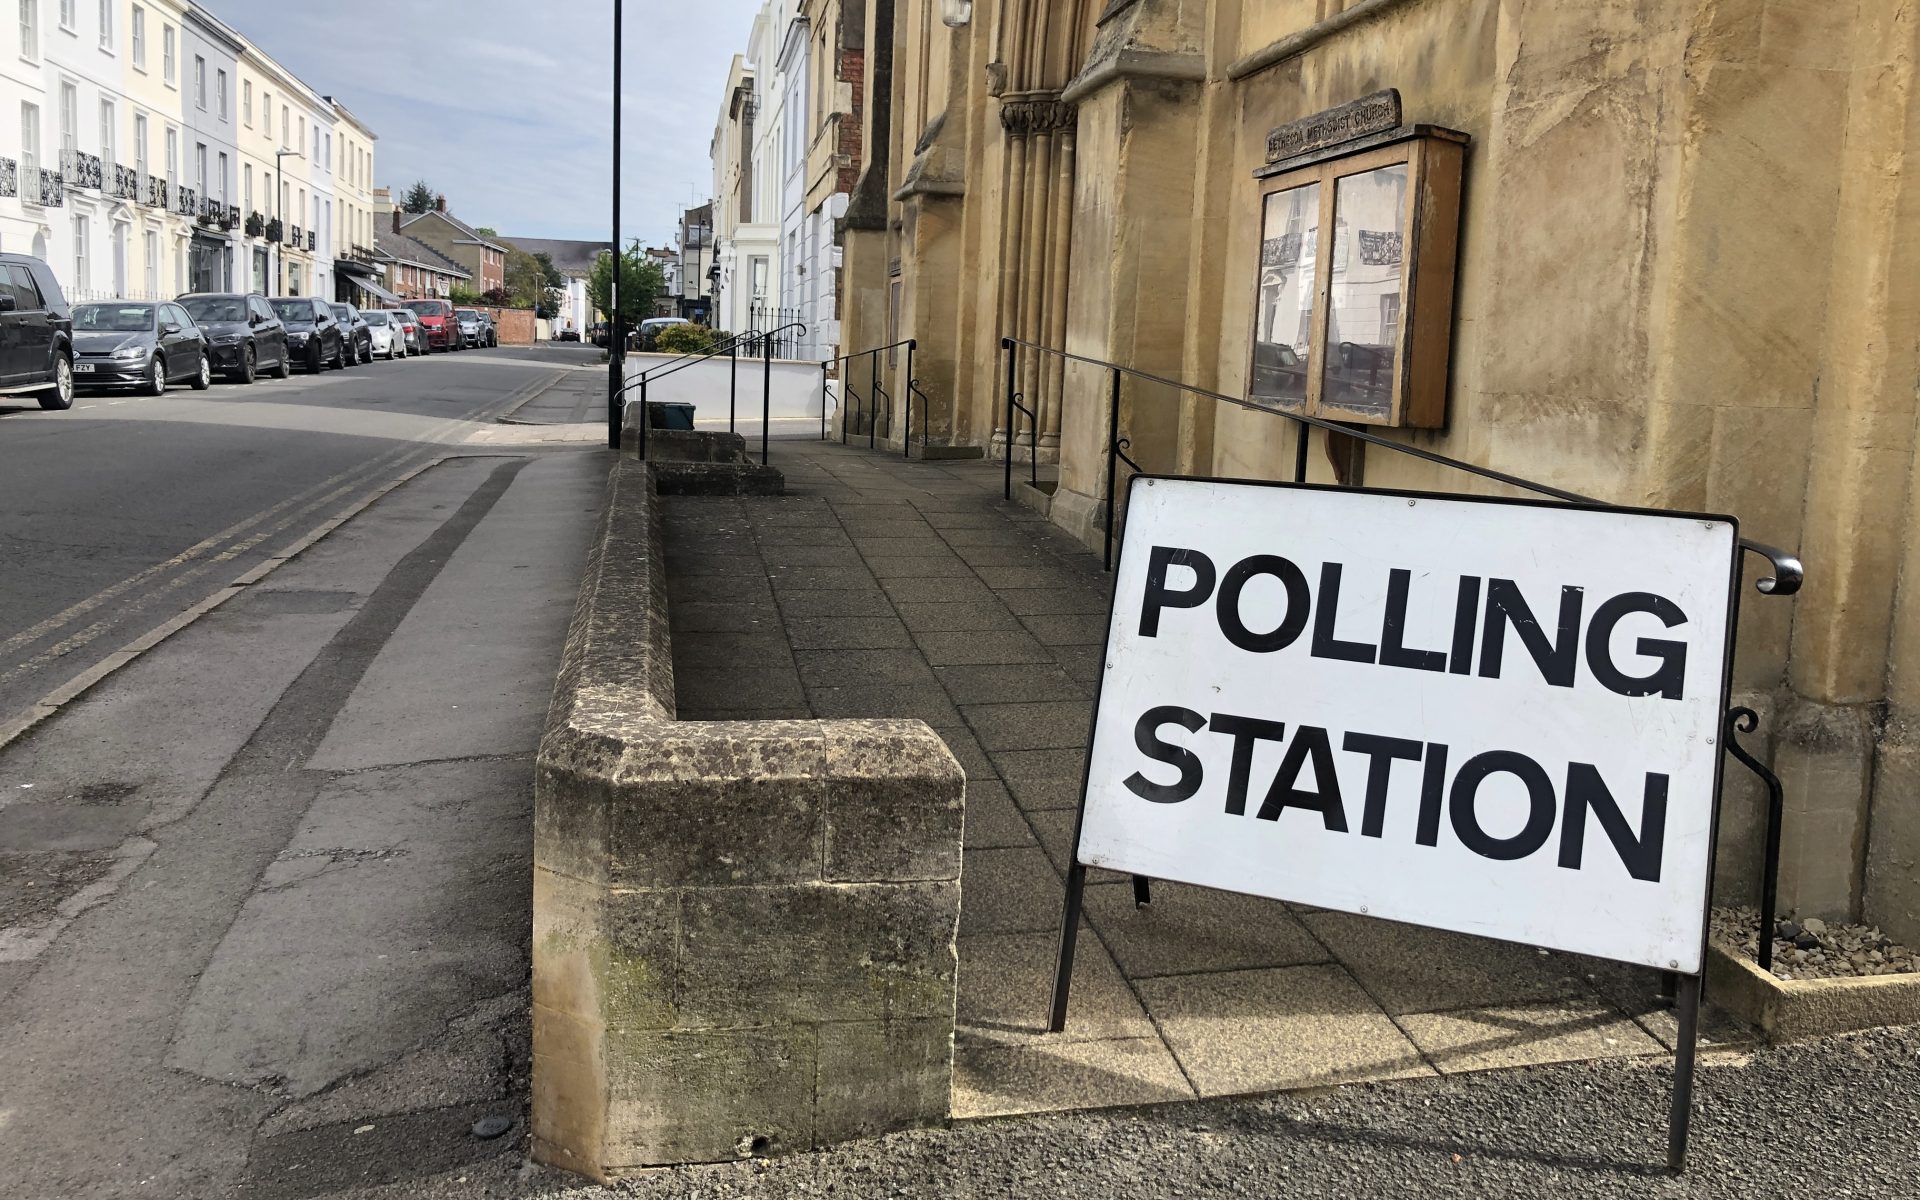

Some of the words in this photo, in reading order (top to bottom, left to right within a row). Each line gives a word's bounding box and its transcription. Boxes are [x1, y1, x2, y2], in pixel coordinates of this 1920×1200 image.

[1268, 130, 1304, 152] BETHESDA
[1307, 114, 1351, 140] METHODIST
[1354, 102, 1391, 126] CHURCH
[1139, 545, 1688, 700] POLLING
[1123, 705, 1669, 883] STATION
